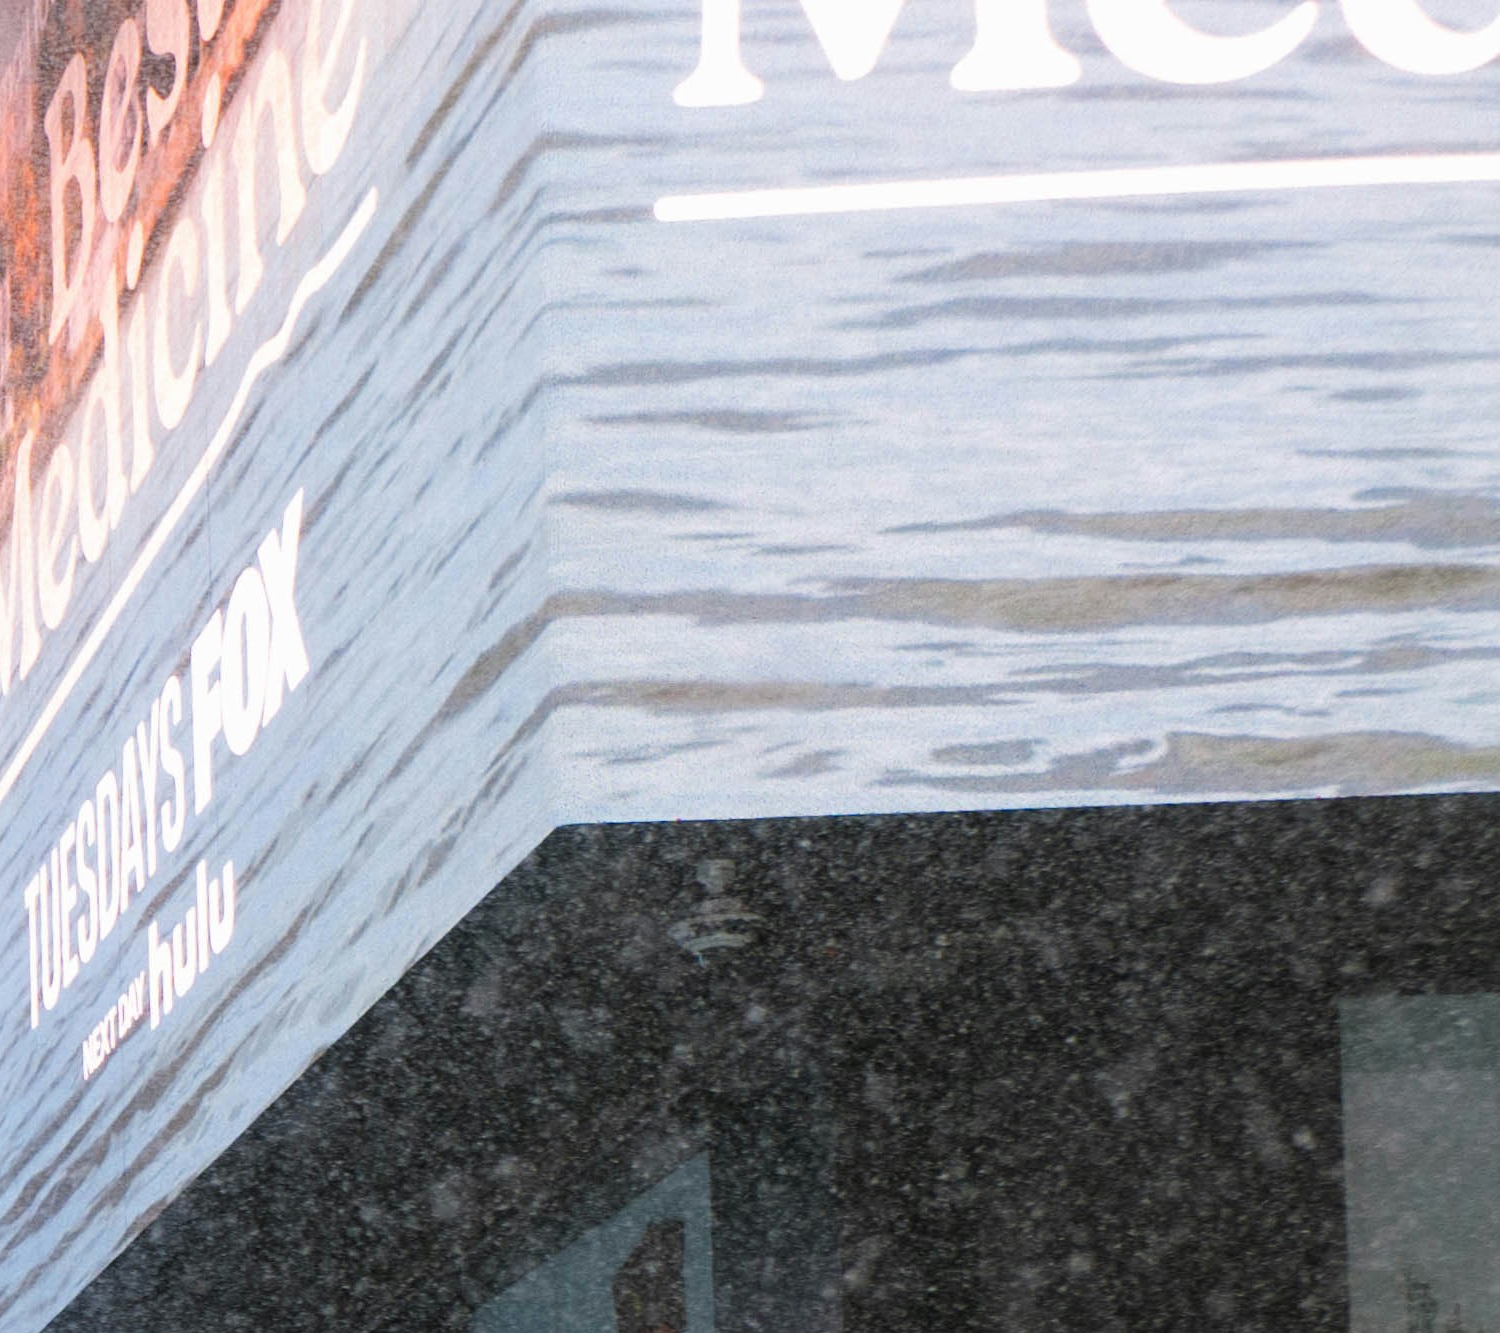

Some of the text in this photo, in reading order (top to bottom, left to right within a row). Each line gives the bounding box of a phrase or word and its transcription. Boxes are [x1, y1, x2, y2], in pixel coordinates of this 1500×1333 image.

[43, 0, 225, 346] Bes
[191, 486, 310, 816] FOX
[24, 674, 184, 1030] TUESDAYS
[82, 860, 238, 1081] NEXT DAY hulu
